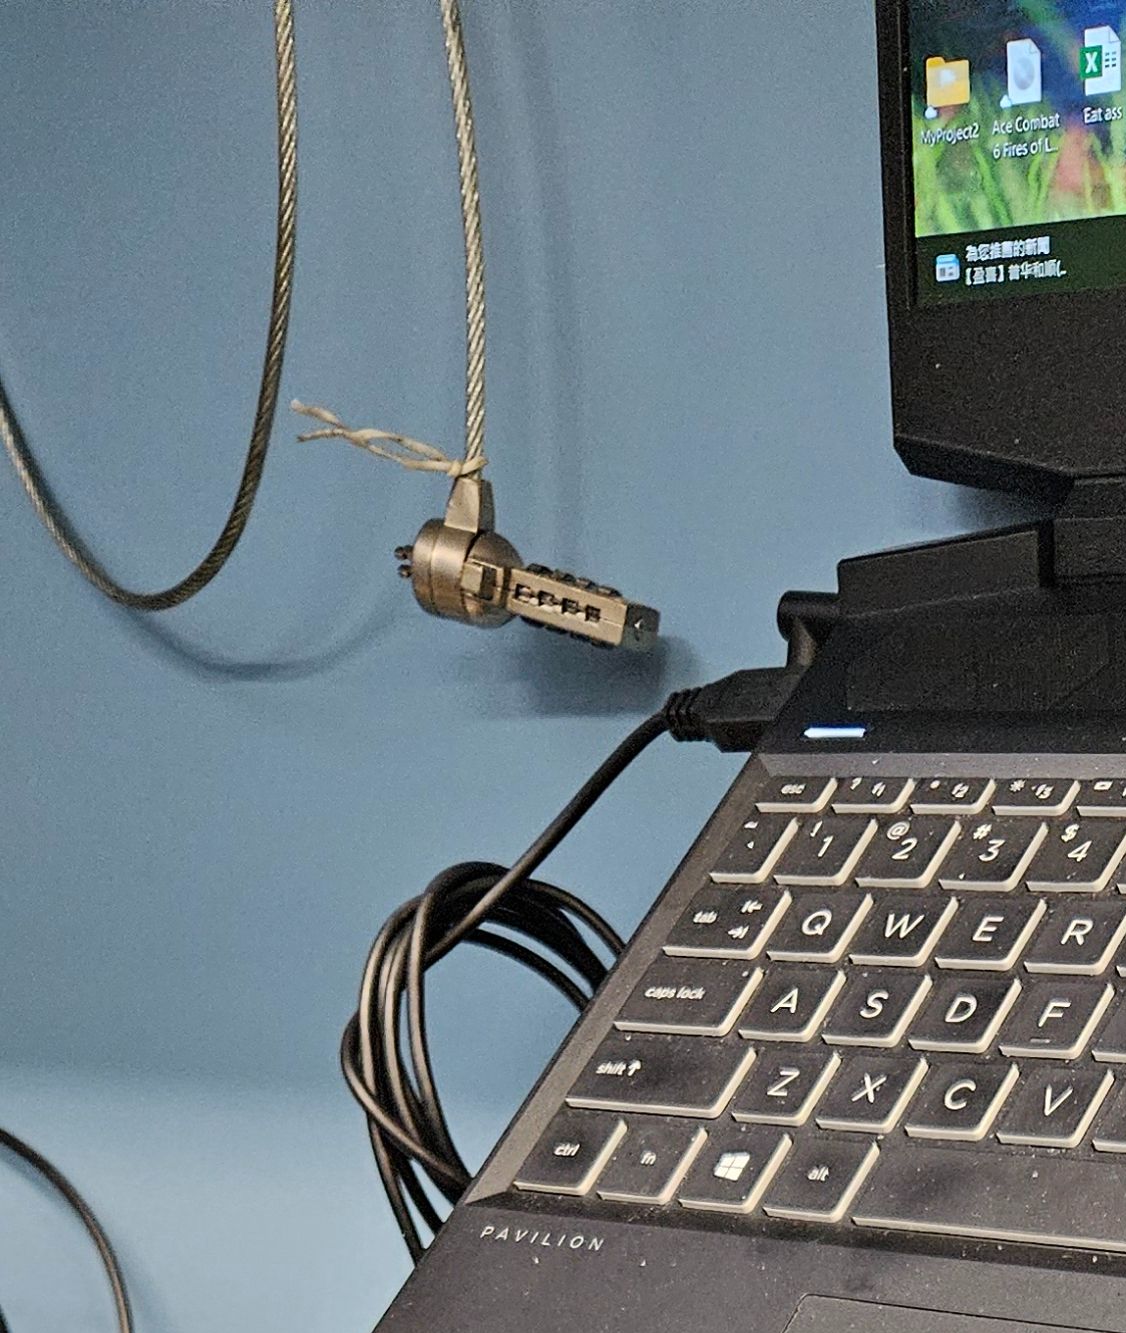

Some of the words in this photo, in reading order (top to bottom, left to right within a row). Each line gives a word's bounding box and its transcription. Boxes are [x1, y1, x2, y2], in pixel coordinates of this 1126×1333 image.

[991, 119, 1013, 136] Ace
[1014, 113, 1060, 131] Combat
[1083, 106, 1103, 124] Eat
[1104, 104, 1124, 122] ass
[918, 121, 980, 148] MyProject2
[991, 143, 1001, 159] 6
[1001, 140, 1027, 158] Fires
[1030, 138, 1044, 155] of
[780, 784, 805, 795] esc
[817, 835, 834, 857] 1
[889, 834, 918, 860] 2
[978, 839, 1006, 862] 3
[1067, 840, 1092, 862] 4
[692, 911, 718, 924] tab
[801, 909, 833, 936] Q
[884, 913, 925, 939] W
[972, 915, 1004, 942] E
[1060, 918, 1093, 946] R
[644, 986, 677, 1000] caps
[676, 986, 706, 1000] lock
[770, 987, 799, 1014] A
[859, 991, 889, 1019] S
[945, 995, 977, 1023] D
[1038, 1000, 1072, 1027] F
[595, 1061, 627, 1076] shift
[766, 1068, 800, 1097] Z
[851, 1073, 887, 1103] X
[944, 1079, 977, 1110] C
[1044, 1085, 1073, 1116] V
[553, 1143, 580, 1156] ctrl
[640, 1151, 657, 1165] fn
[807, 1166, 829, 1182] alt
[479, 1225, 604, 1251] PAVILION
